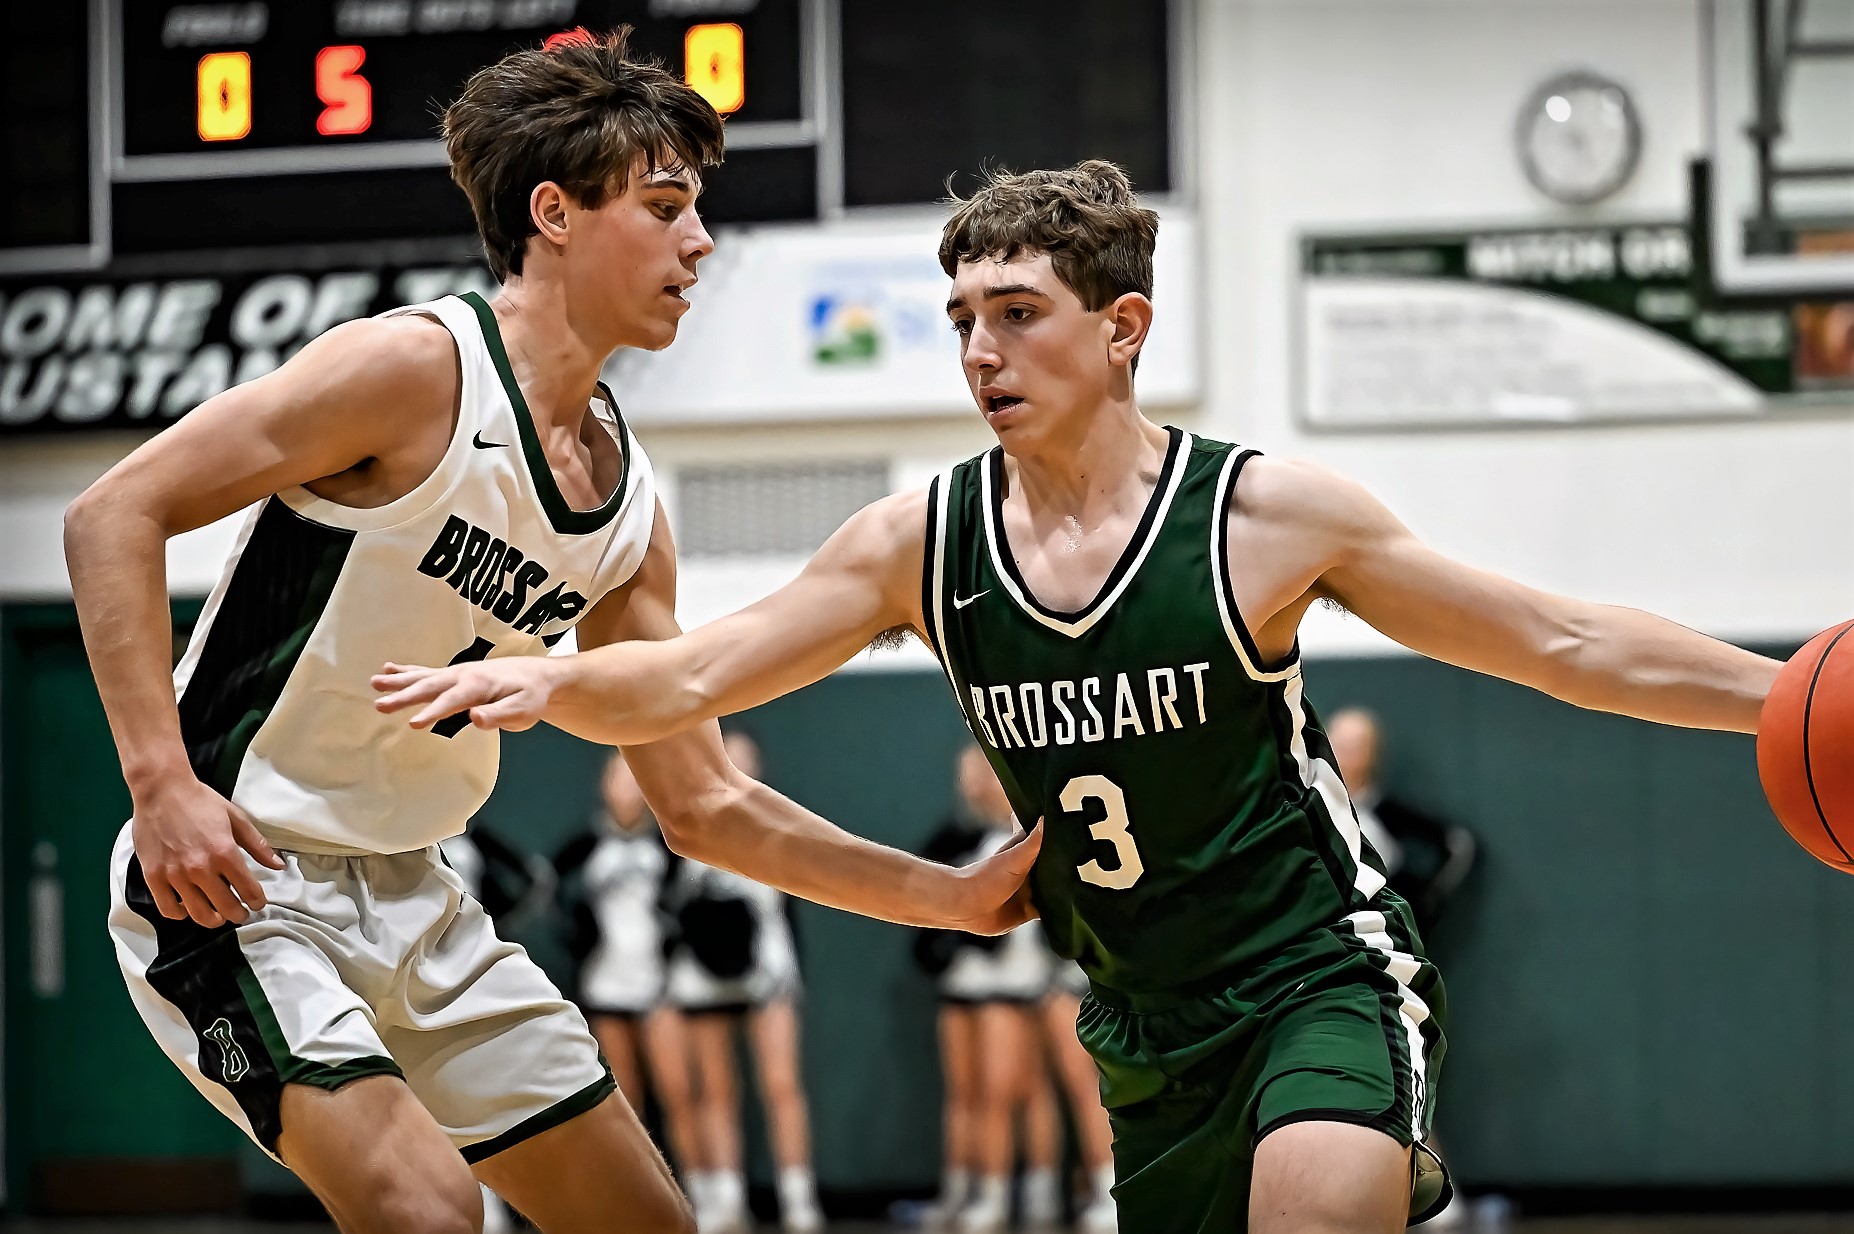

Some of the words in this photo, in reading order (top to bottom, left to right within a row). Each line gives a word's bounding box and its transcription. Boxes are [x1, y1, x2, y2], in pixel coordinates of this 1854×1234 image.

[197, 52, 251, 142] 0
[316, 45, 372, 136] 5
[0, 280, 222, 355] OME
[970, 661, 1210, 749] BROSSART
[1059, 774, 1145, 890] 3
